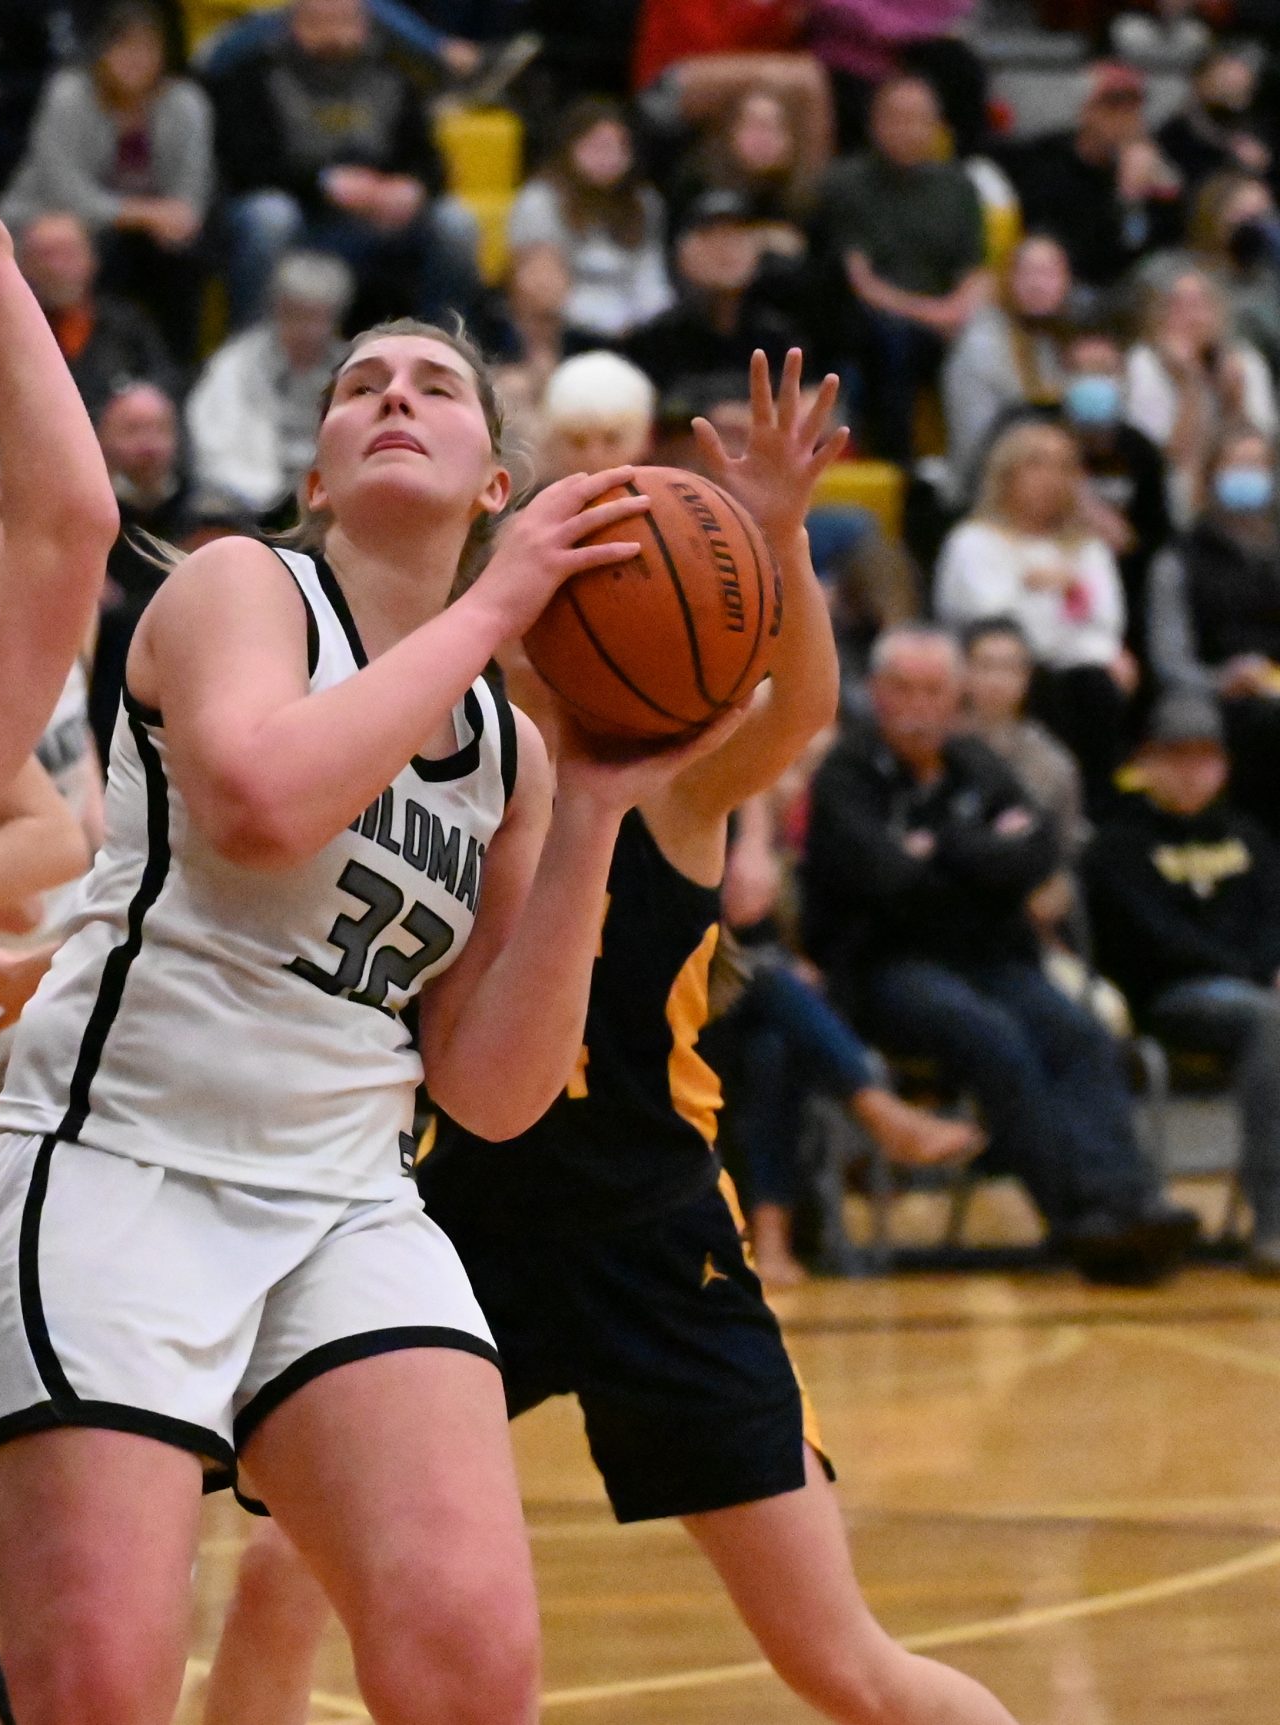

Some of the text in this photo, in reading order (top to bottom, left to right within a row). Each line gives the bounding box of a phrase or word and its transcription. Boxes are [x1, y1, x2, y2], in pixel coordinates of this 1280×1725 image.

[669, 481, 746, 633] EVOLUTION
[347, 785, 486, 916] ILOMA
[281, 858, 455, 1020] 32
